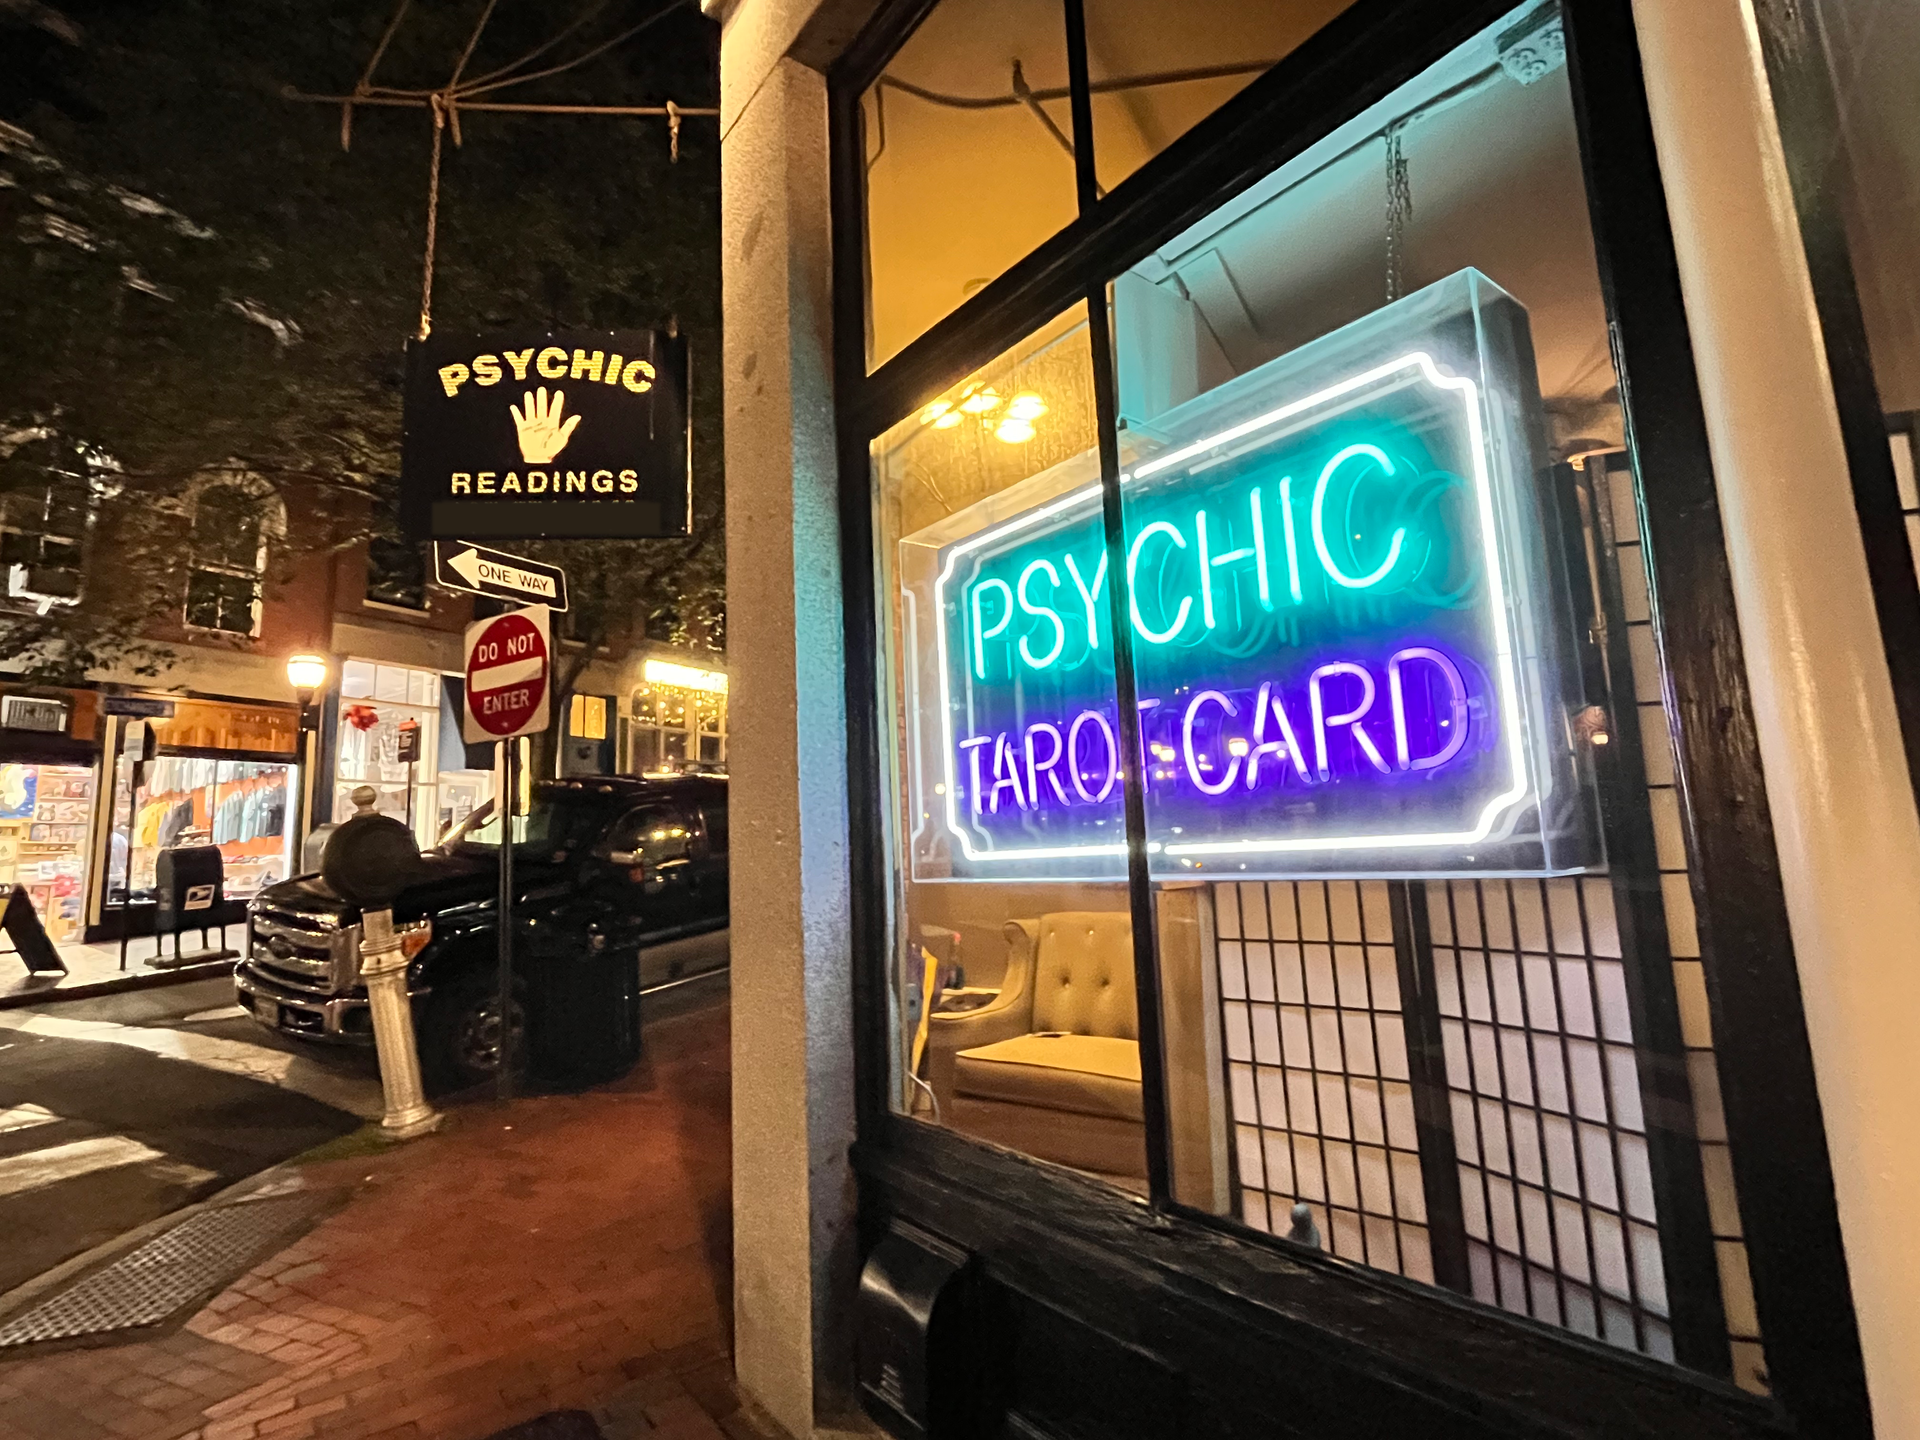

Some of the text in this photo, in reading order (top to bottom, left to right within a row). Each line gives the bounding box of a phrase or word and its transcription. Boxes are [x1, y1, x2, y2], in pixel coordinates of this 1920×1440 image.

[438, 346, 657, 398] PSYCHIC
[450, 469, 640, 495] READINGS
[972, 442, 1408, 680] PSYCHIC
[478, 563, 549, 592] ONE WAY
[478, 631, 536, 663] DO NOT
[483, 688, 530, 715] ENTER
[1182, 646, 1470, 797] CARD
